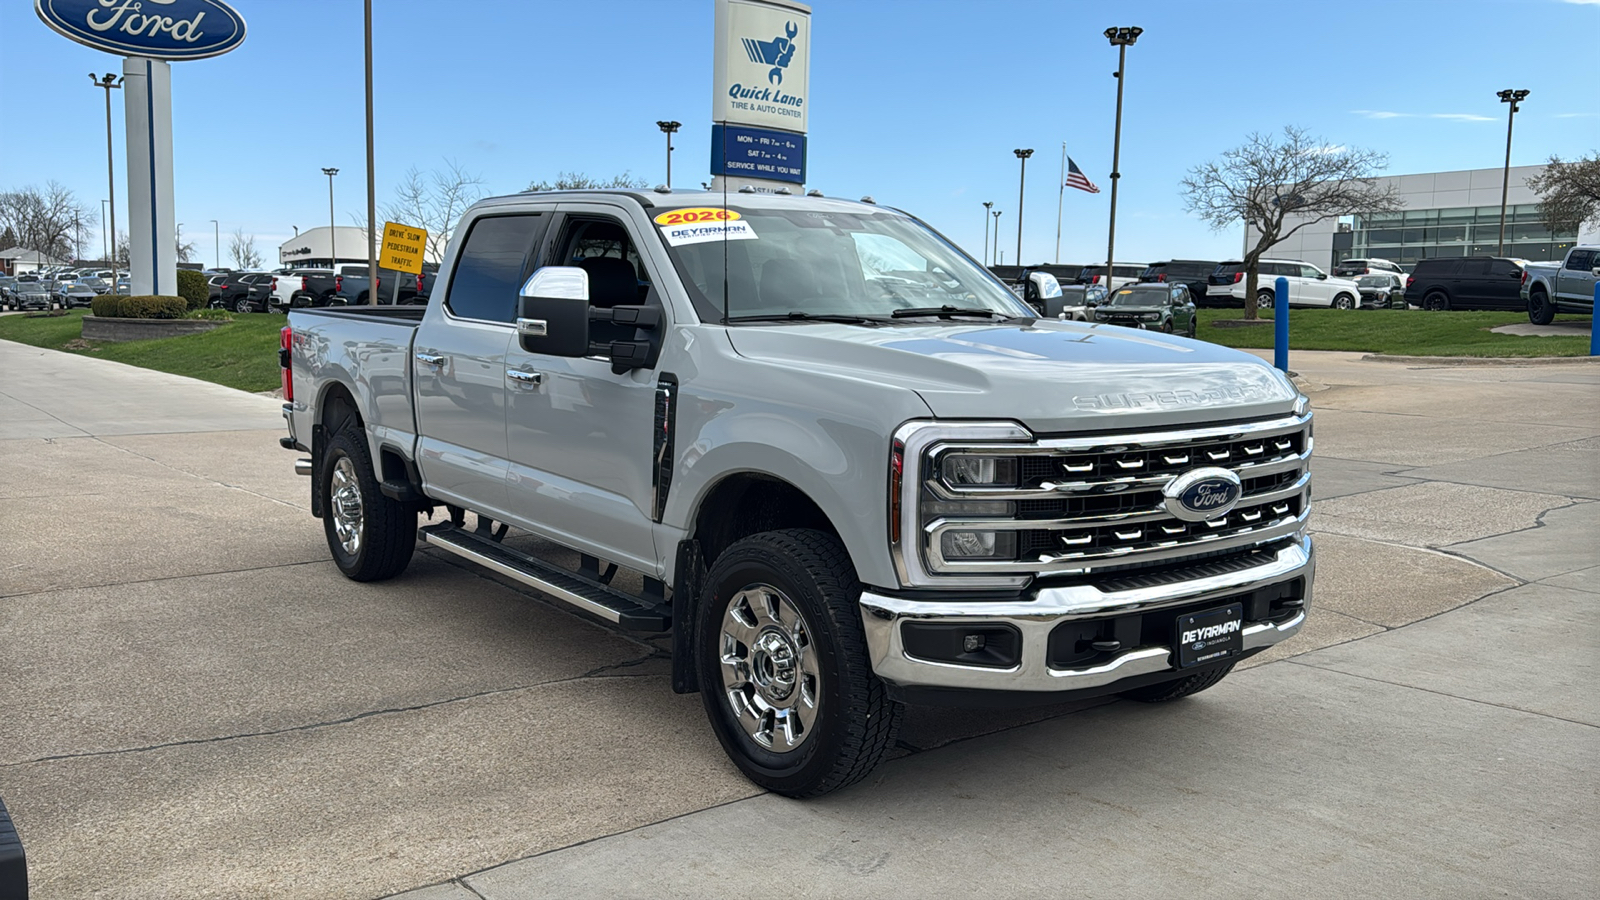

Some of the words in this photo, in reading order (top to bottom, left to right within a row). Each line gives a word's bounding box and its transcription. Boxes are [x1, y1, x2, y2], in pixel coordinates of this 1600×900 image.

[86, 0, 206, 42] Ford
[729, 83, 772, 101] Quick
[772, 90, 803, 107] Lane
[731, 101, 748, 110] TIRE
[750, 103, 755, 111] &
[757, 104, 776, 113] AUTO
[777, 108, 801, 118] CENTER
[737, 135, 753, 143] MON
[760, 137, 770, 145] FRI
[727, 161, 755, 170] SERVICE
[757, 164, 775, 172] WHILE
[777, 166, 789, 174] YOU
[789, 168, 801, 176] WAIT
[666, 210, 731, 224] 2026
[389, 229, 404, 238] DRIVE
[407, 232, 420, 241] SLOW
[671, 225, 746, 237] DEYARMAN
[387, 242, 418, 254] PEDESTRIAN
[391, 256, 412, 267] TRAFFIC
[1072, 389, 1203, 409] SUPER
[1193, 483, 1229, 507] Ford
[1182, 619, 1241, 645] DEYARMAN
[1206, 636, 1231, 646] INDIANOLA
